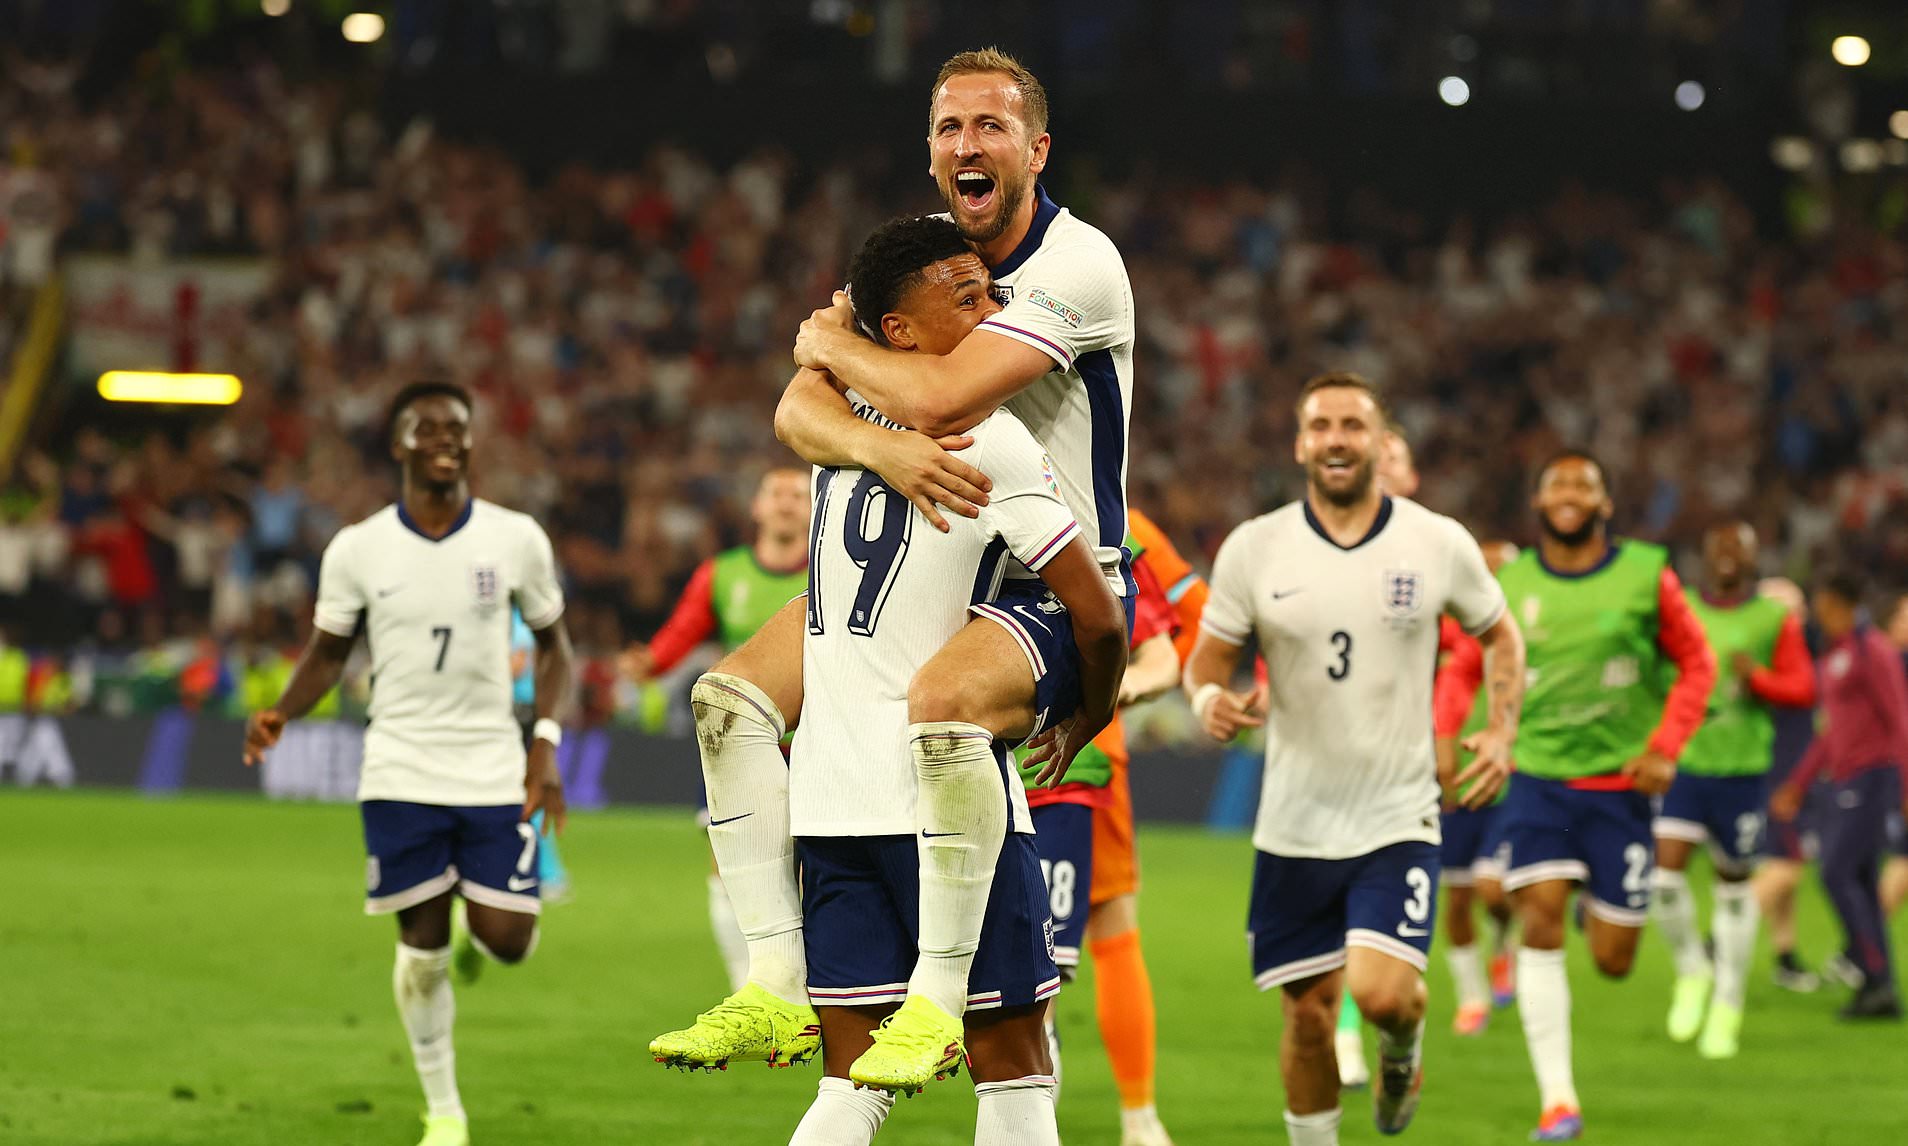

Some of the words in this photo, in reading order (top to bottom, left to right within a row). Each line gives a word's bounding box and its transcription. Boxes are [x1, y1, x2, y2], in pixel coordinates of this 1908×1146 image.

[1029, 292, 1083, 325] FOUNDATION
[807, 465, 914, 638] 19
[432, 626, 453, 672] 7
[1327, 630, 1353, 682] 3
[516, 821, 537, 876] 7
[1404, 866, 1431, 924] 3
